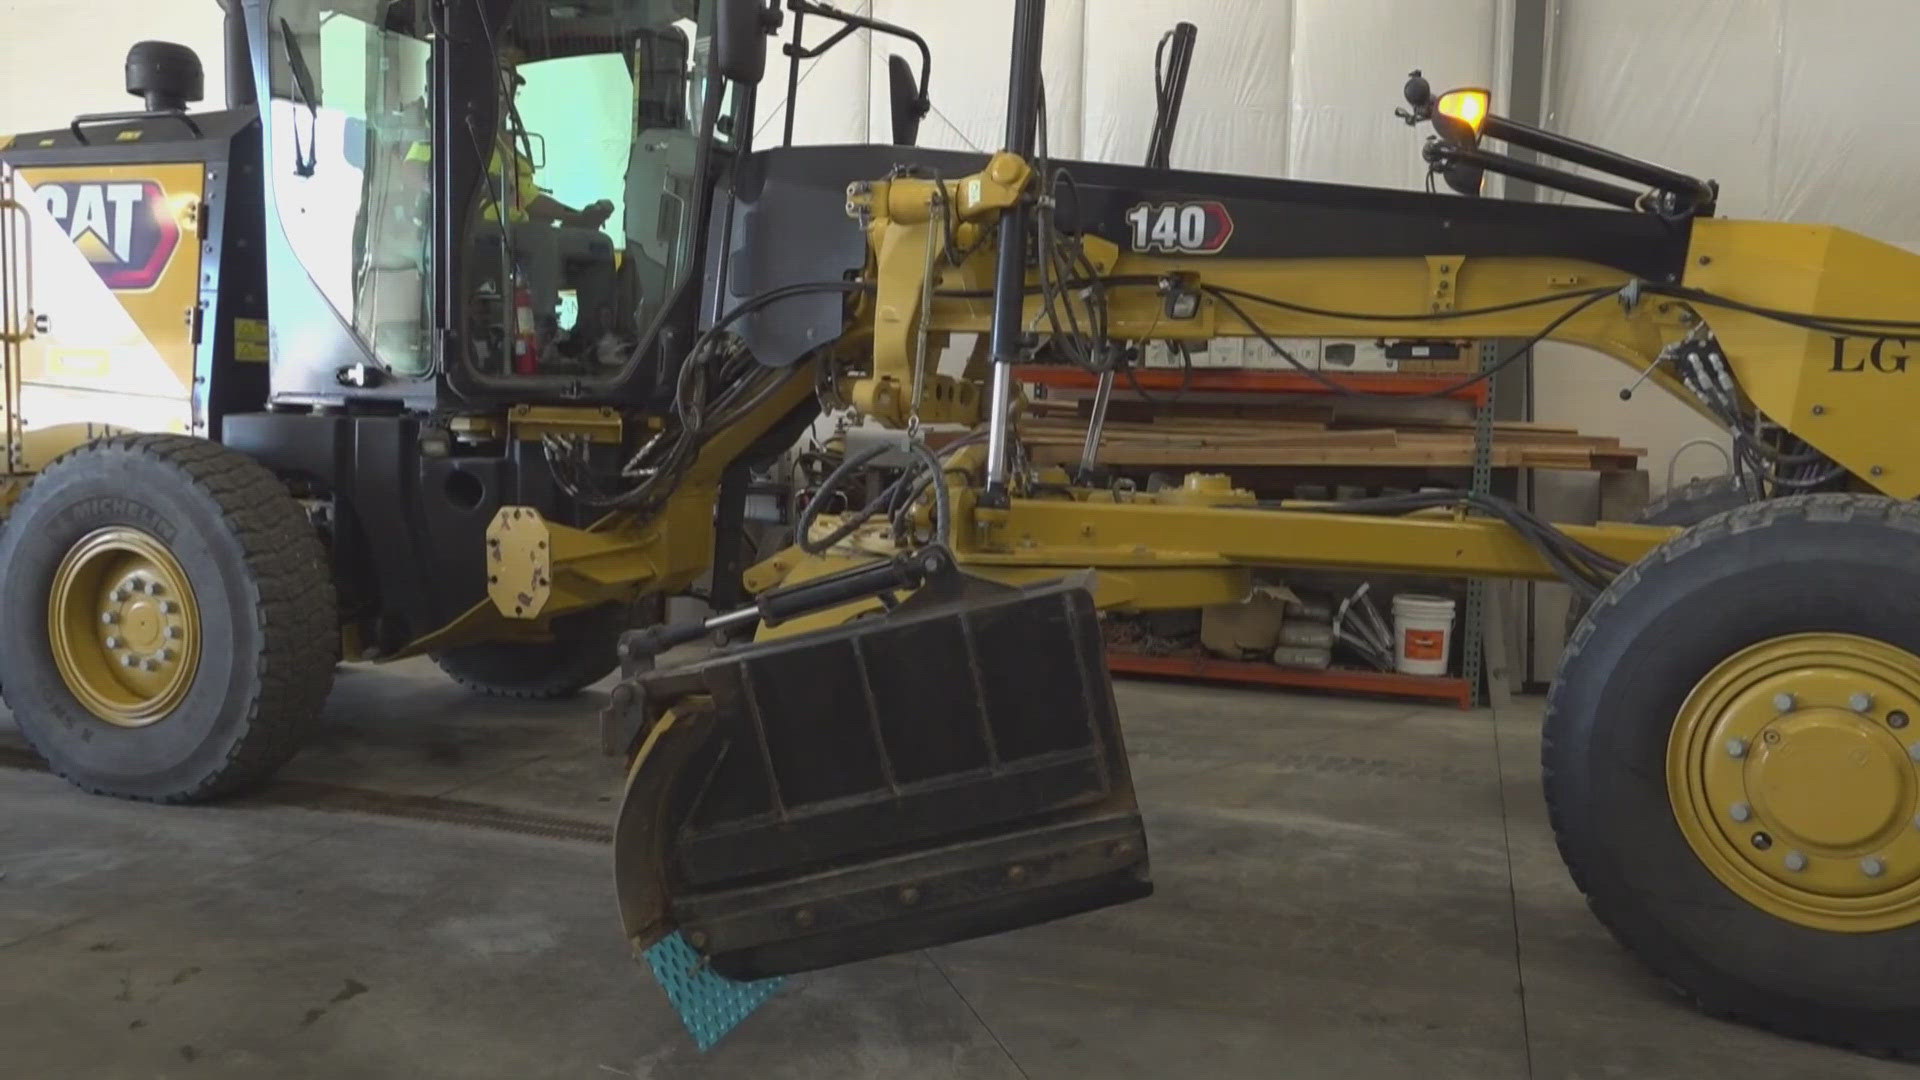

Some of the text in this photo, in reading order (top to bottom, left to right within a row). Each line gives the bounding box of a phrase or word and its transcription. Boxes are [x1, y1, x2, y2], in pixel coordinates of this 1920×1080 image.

[1129, 205, 1206, 249] 140
[1827, 335, 1911, 374] LG
[71, 498, 177, 541] MICHELIN
